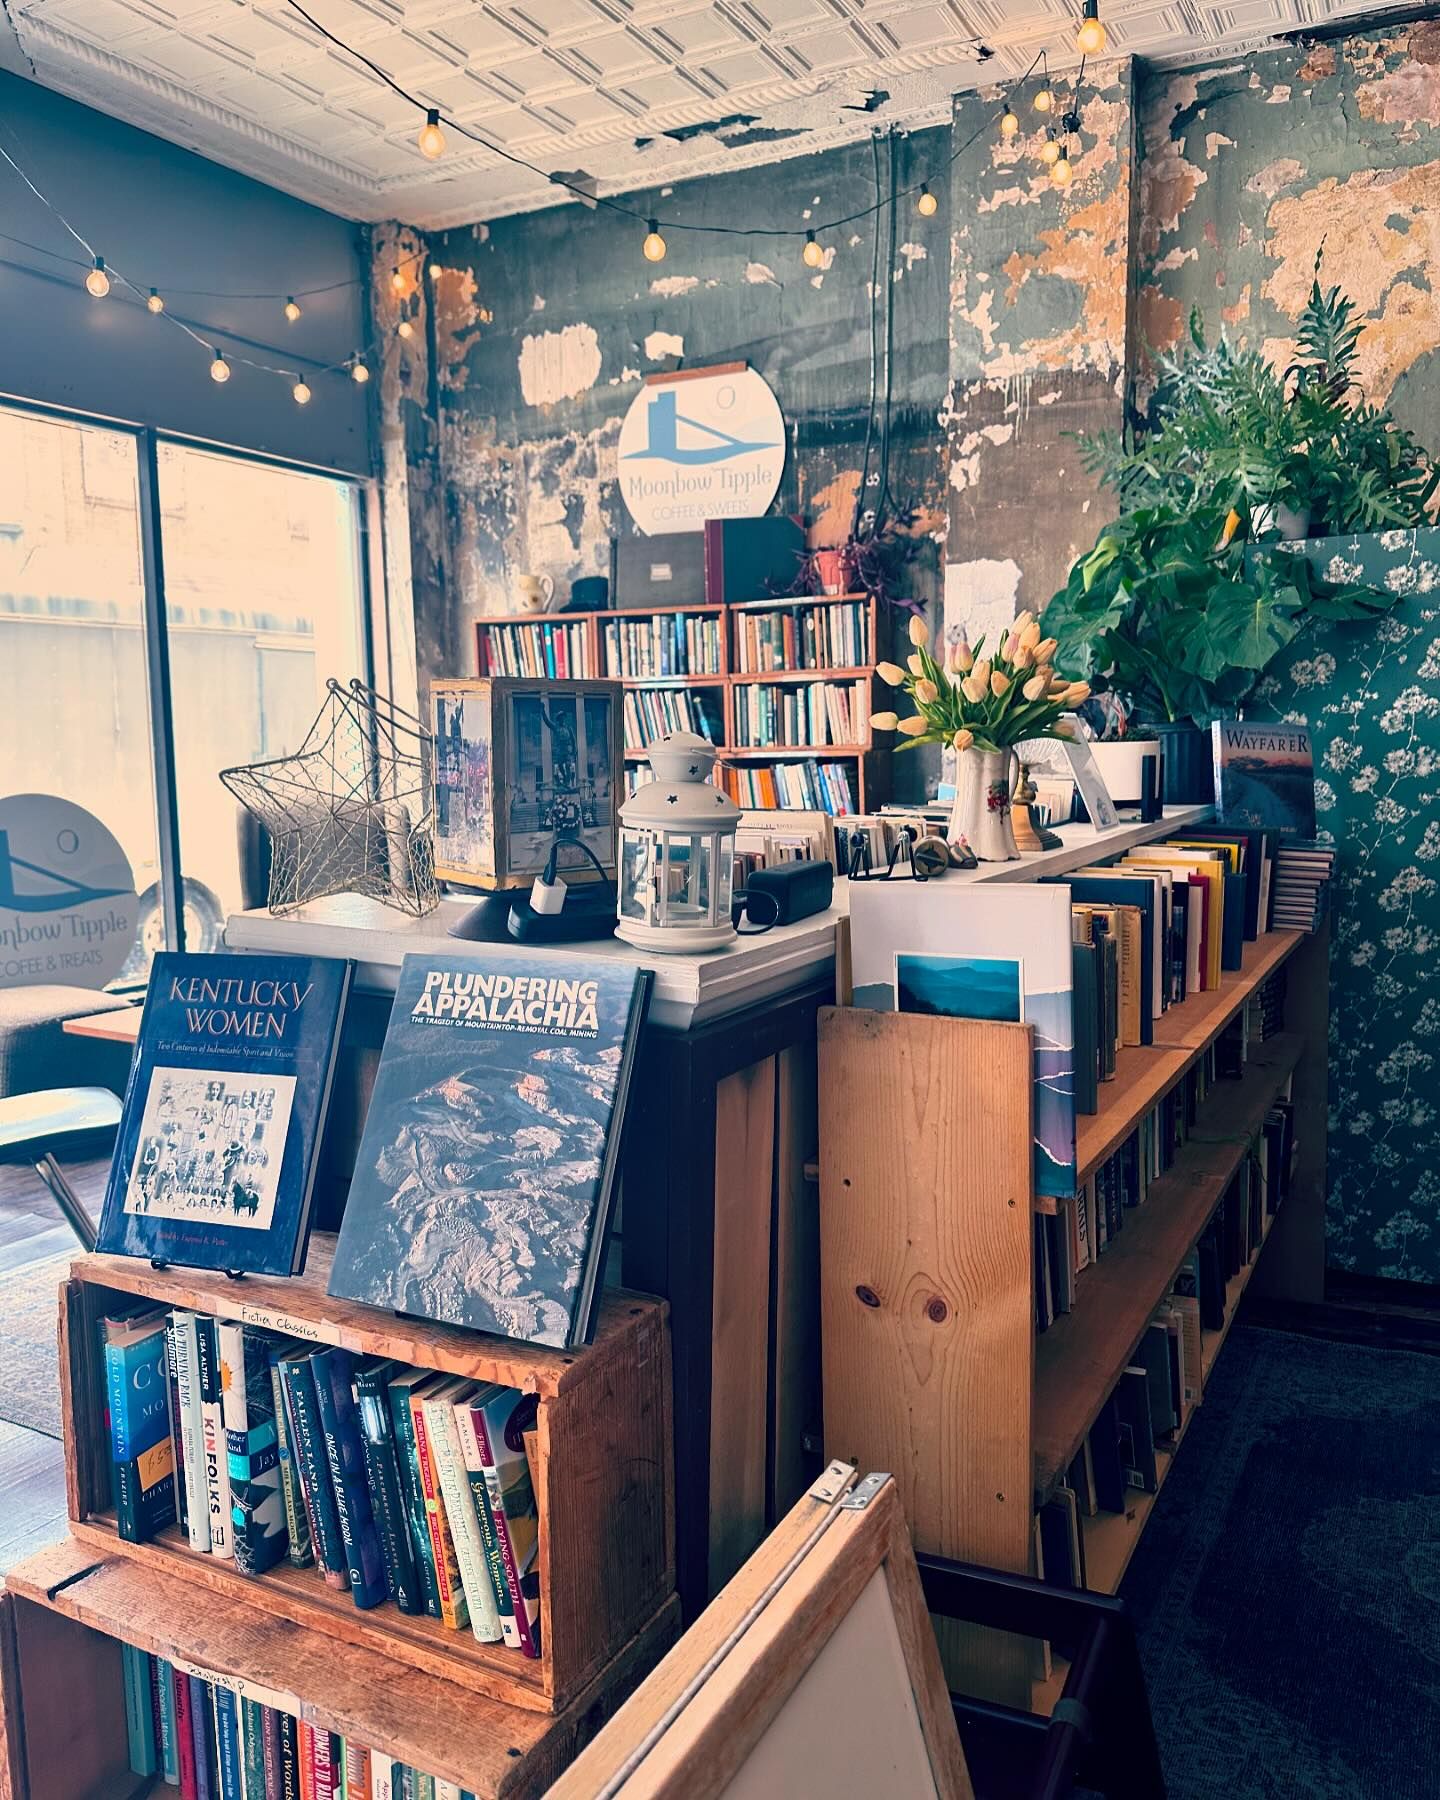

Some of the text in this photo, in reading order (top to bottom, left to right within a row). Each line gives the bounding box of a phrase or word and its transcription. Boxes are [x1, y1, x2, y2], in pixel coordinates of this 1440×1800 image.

[629, 464, 772, 499] Moonbow Tipple
[1226, 730, 1308, 752] WAYFARER
[60, 911, 127, 942] Tipple
[46, 954, 57, 971] &
[59, 948, 103, 969] TREATS
[168, 977, 314, 1012] KENTUCKY
[424, 971, 599, 1005] PLUNDERING
[186, 1008, 287, 1038] WOMEN
[410, 1016, 597, 1039] THE TRAGEDY OF MOUNTAINTOP-REMOVAL COAL MINING
[411, 992, 600, 1030] APPALACHIA
[166, 1327, 178, 1378] Skidmore
[177, 1340, 190, 1381] TURNING
[200, 1355, 209, 1390] ALTHER
[110, 1348, 126, 1456] COLD MOUNTAIN
[180, 1385, 191, 1408] BACK
[296, 1391, 318, 1492] FALLEN LAND
[414, 1414, 433, 1493] ADRIANA TRIGIANI
[203, 1418, 220, 1514] KINFOLKS
[325, 1432, 353, 1546] ONCE IN A BLUE MOON
[430, 1516, 438, 1529] BIG
[471, 1482, 494, 1548] Generous
[489, 1550, 504, 1600] Women
[494, 1519, 520, 1604] FLYING SOUTH
[283, 1739, 292, 1756] of
[284, 1757, 294, 1800] Words
